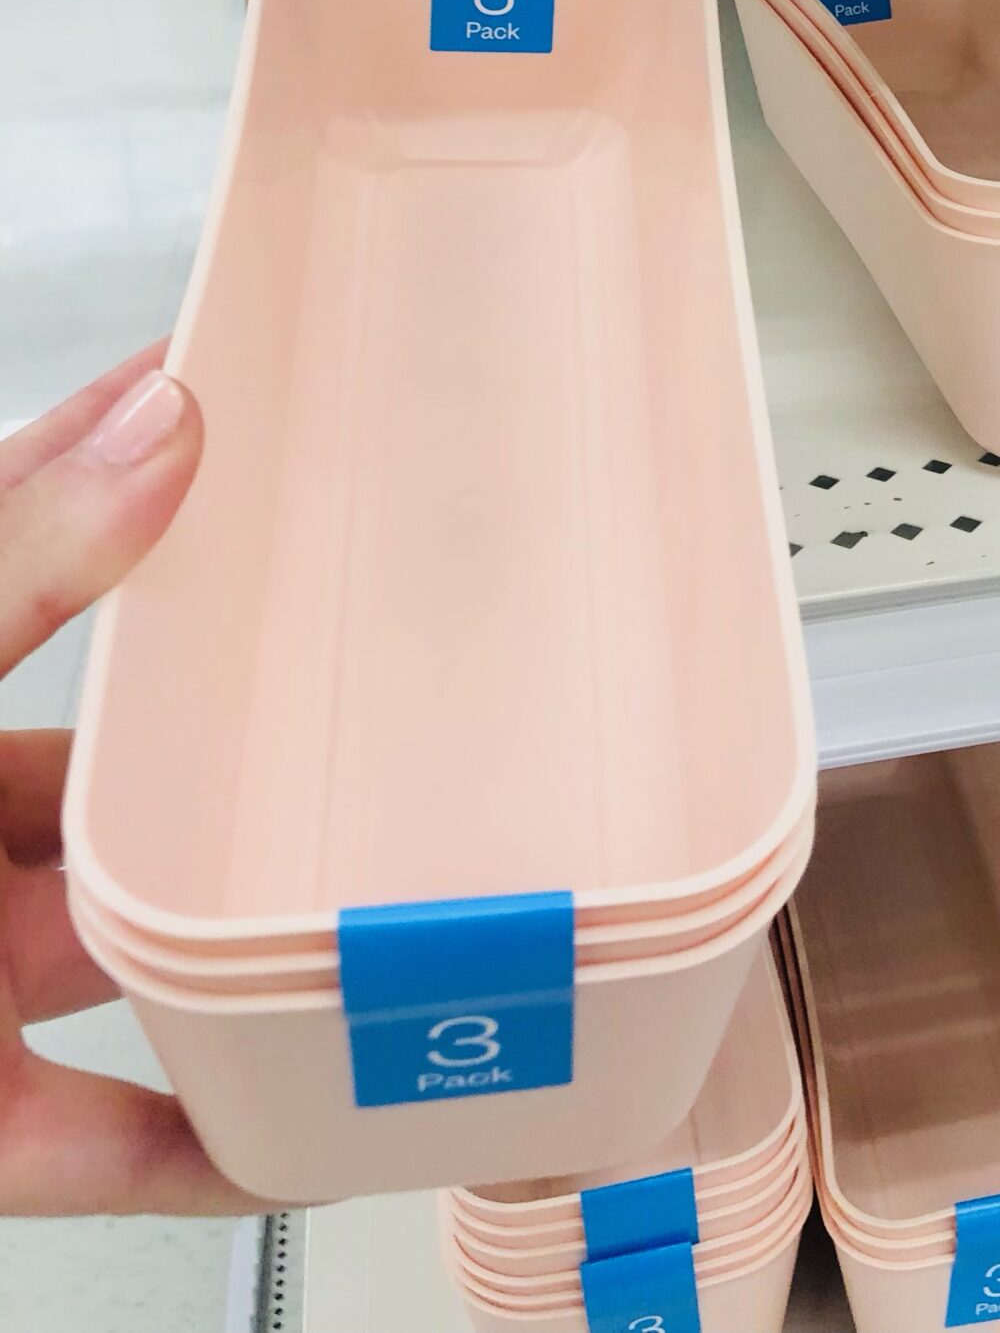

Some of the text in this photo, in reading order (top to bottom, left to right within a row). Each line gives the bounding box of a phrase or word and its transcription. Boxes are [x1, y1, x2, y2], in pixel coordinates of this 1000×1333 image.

[834, 2, 870, 17] Pack
[466, 21, 520, 40] Pack
[427, 1015, 500, 1067] 3
[418, 1066, 513, 1092] Pack
